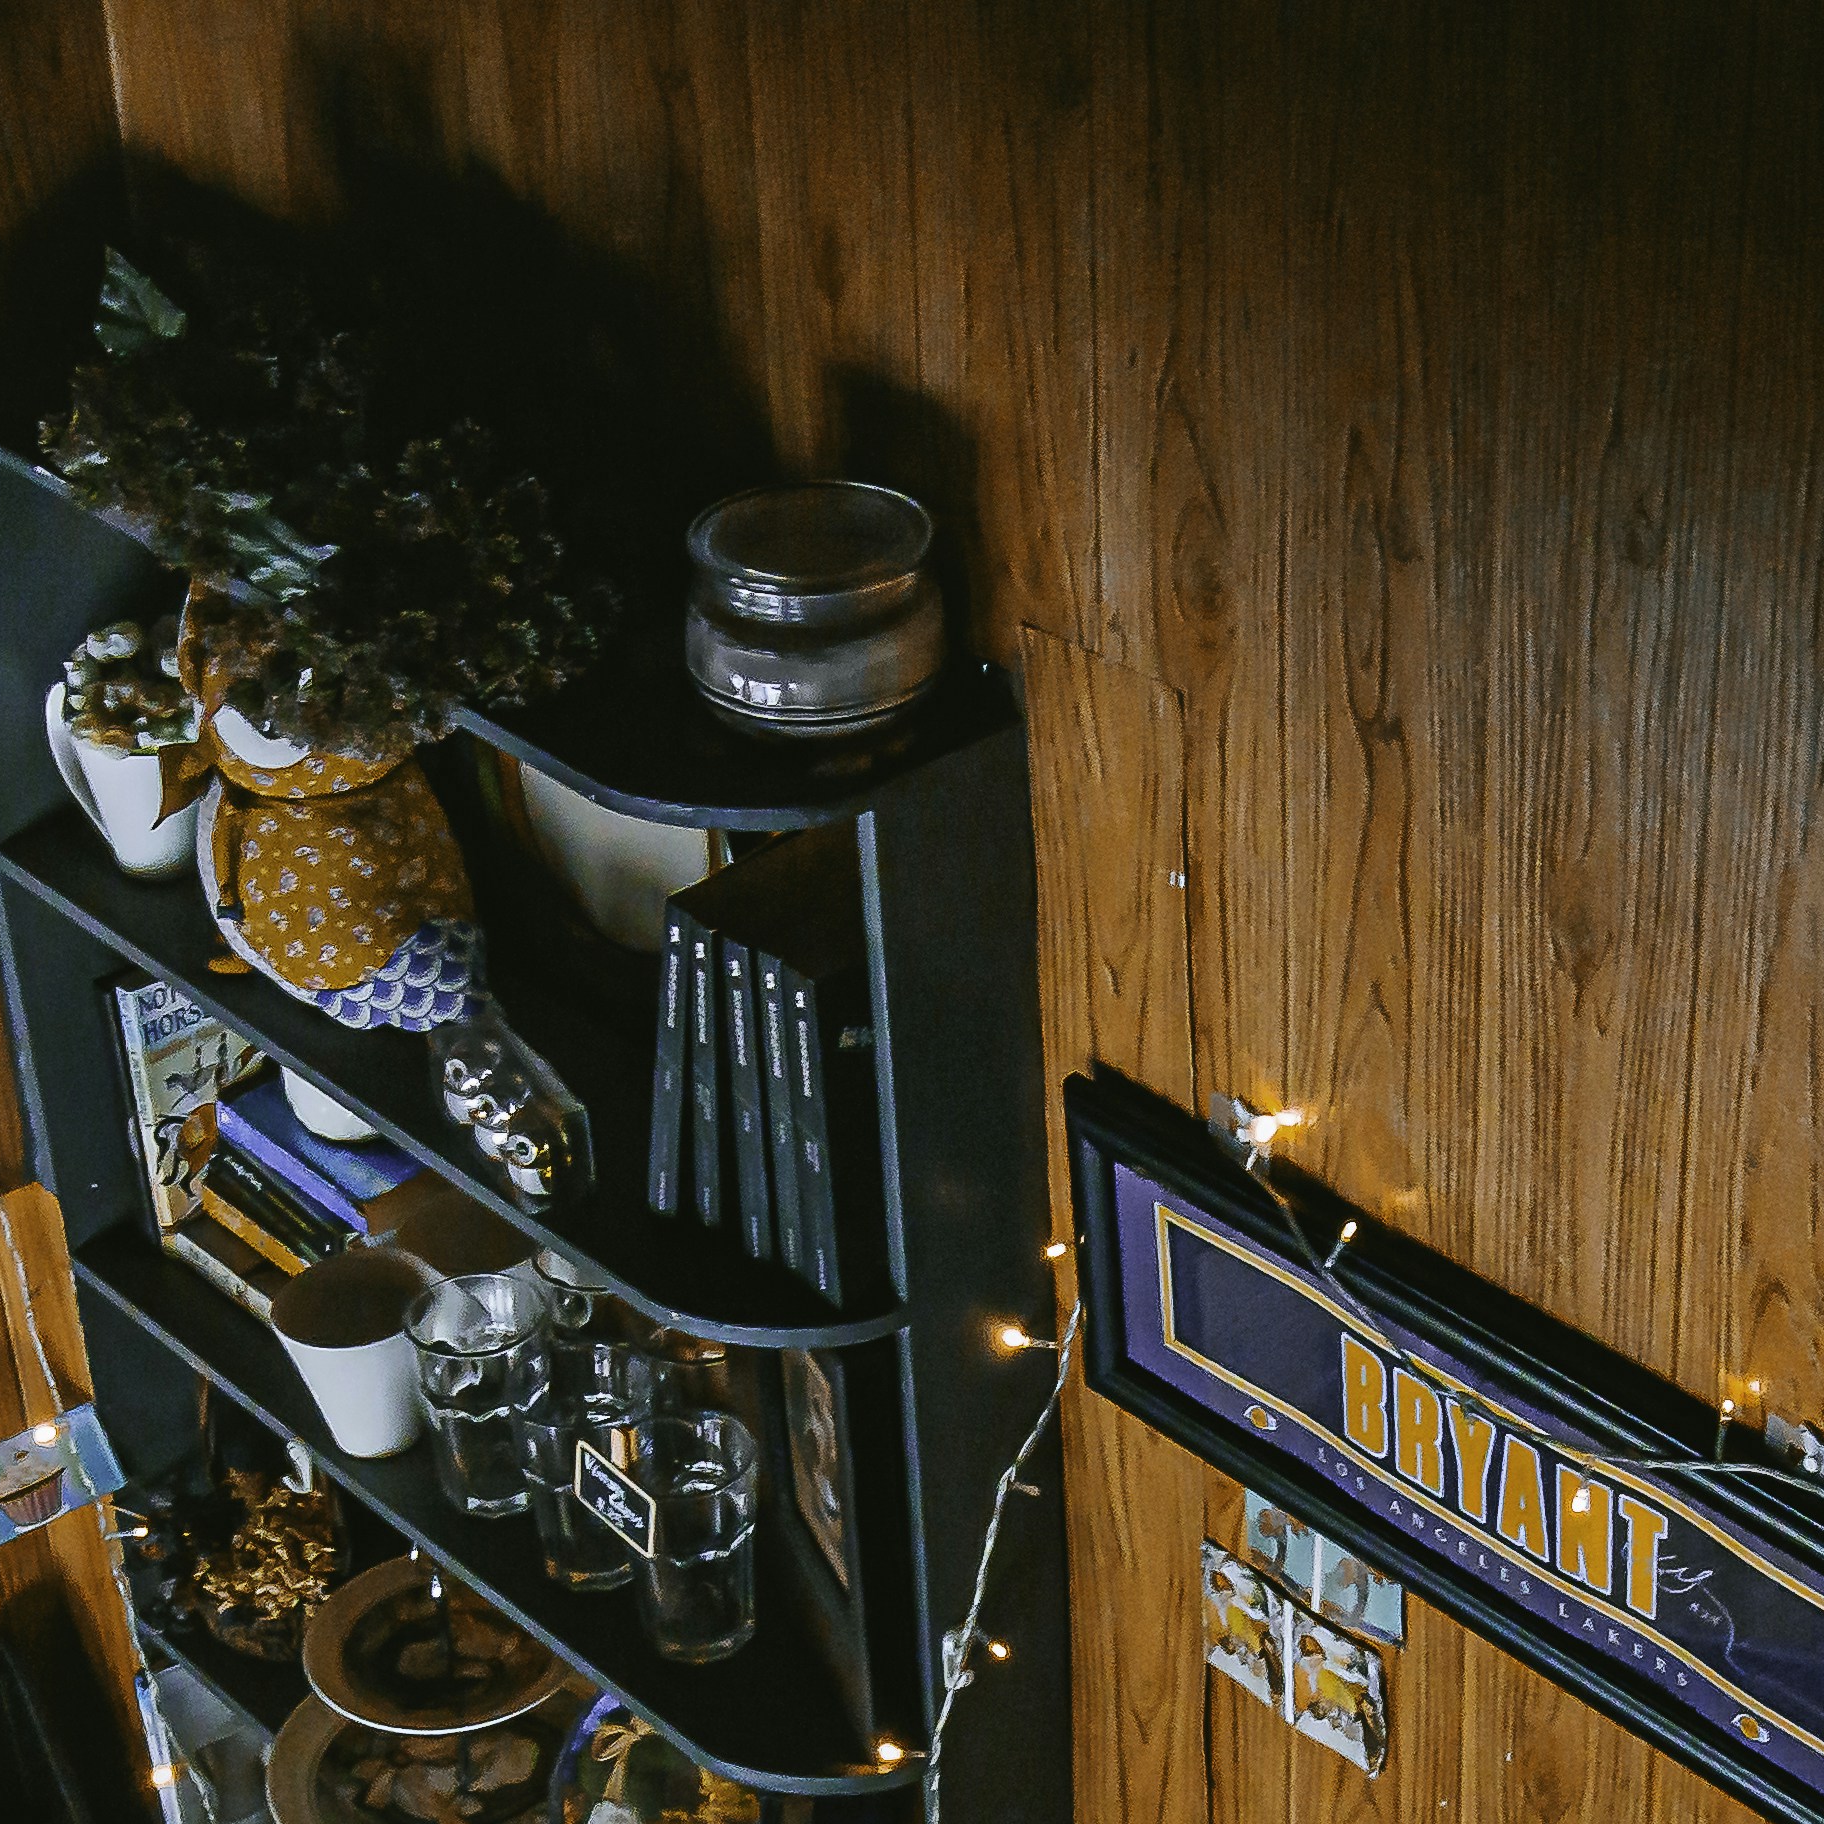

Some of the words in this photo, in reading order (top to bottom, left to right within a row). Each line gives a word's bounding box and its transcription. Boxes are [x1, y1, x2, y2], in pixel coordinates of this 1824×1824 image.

[142, 1003, 213, 1048] HORS
[1316, 1446, 1367, 1492] LOS
[1389, 1499, 1534, 1597] ANGELES
[1557, 1601, 1691, 1688] LAKERS
[1341, 1331, 1669, 1620] BRYANT
